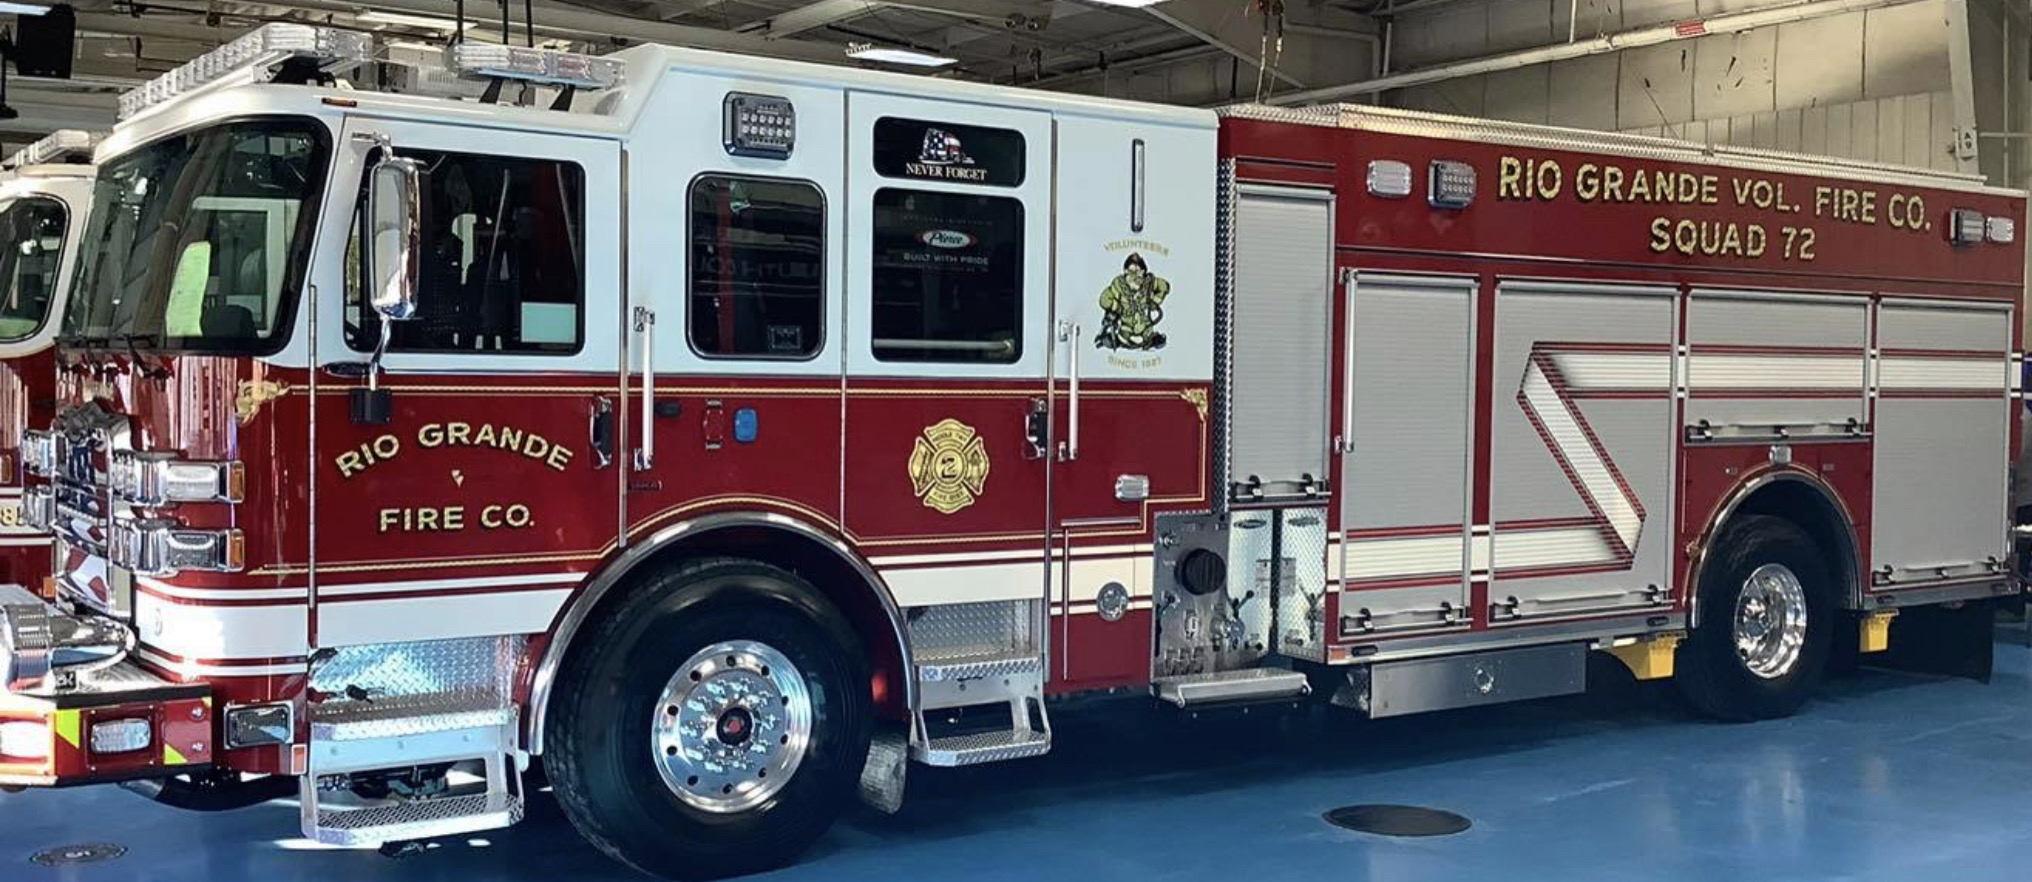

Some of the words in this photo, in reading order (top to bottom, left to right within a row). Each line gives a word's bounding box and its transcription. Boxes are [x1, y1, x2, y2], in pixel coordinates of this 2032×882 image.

[905, 162, 943, 177] NEVER
[945, 166, 988, 181] FORGET
[1499, 156, 1562, 200] RIO
[1576, 163, 1719, 203] GRANDE
[1732, 177, 1801, 213] VOL.
[1815, 186, 1877, 222] FIRE
[1888, 193, 1932, 231] CO.
[1650, 217, 1767, 256] SQUAD
[1781, 226, 1816, 260] 72
[903, 252, 930, 261] BUILT
[933, 254, 957, 263] WITH
[960, 257, 989, 266] PRIDE
[335, 434, 400, 478] RIO
[418, 422, 574, 471] GRANDE
[941, 457, 957, 479] 2
[380, 506, 464, 532] FIRE
[481, 504, 535, 528] CO.
